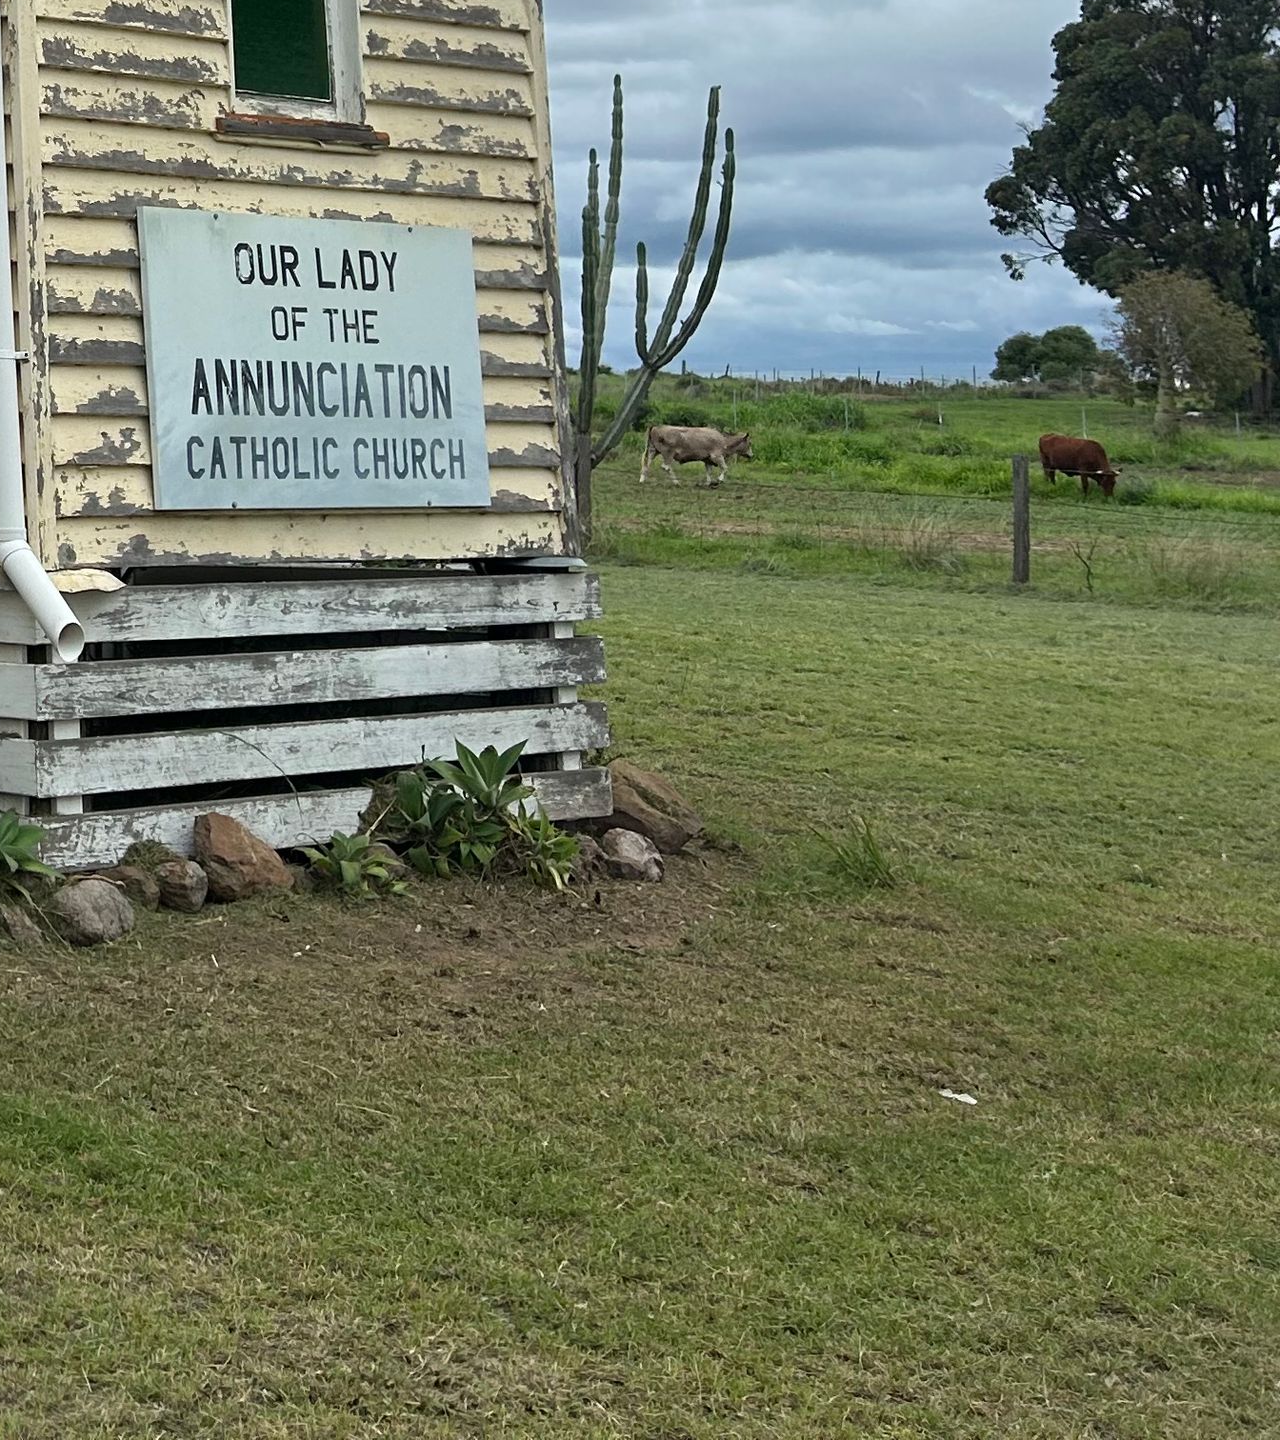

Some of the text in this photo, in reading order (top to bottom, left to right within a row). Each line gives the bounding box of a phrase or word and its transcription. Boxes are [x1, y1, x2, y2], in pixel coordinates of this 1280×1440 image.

[233, 242, 398, 292] OUR LADY
[271, 305, 380, 344] OF THE
[191, 358, 453, 420] ANNUNCIATION
[186, 435, 466, 480] CATHOLIC CHURCH
